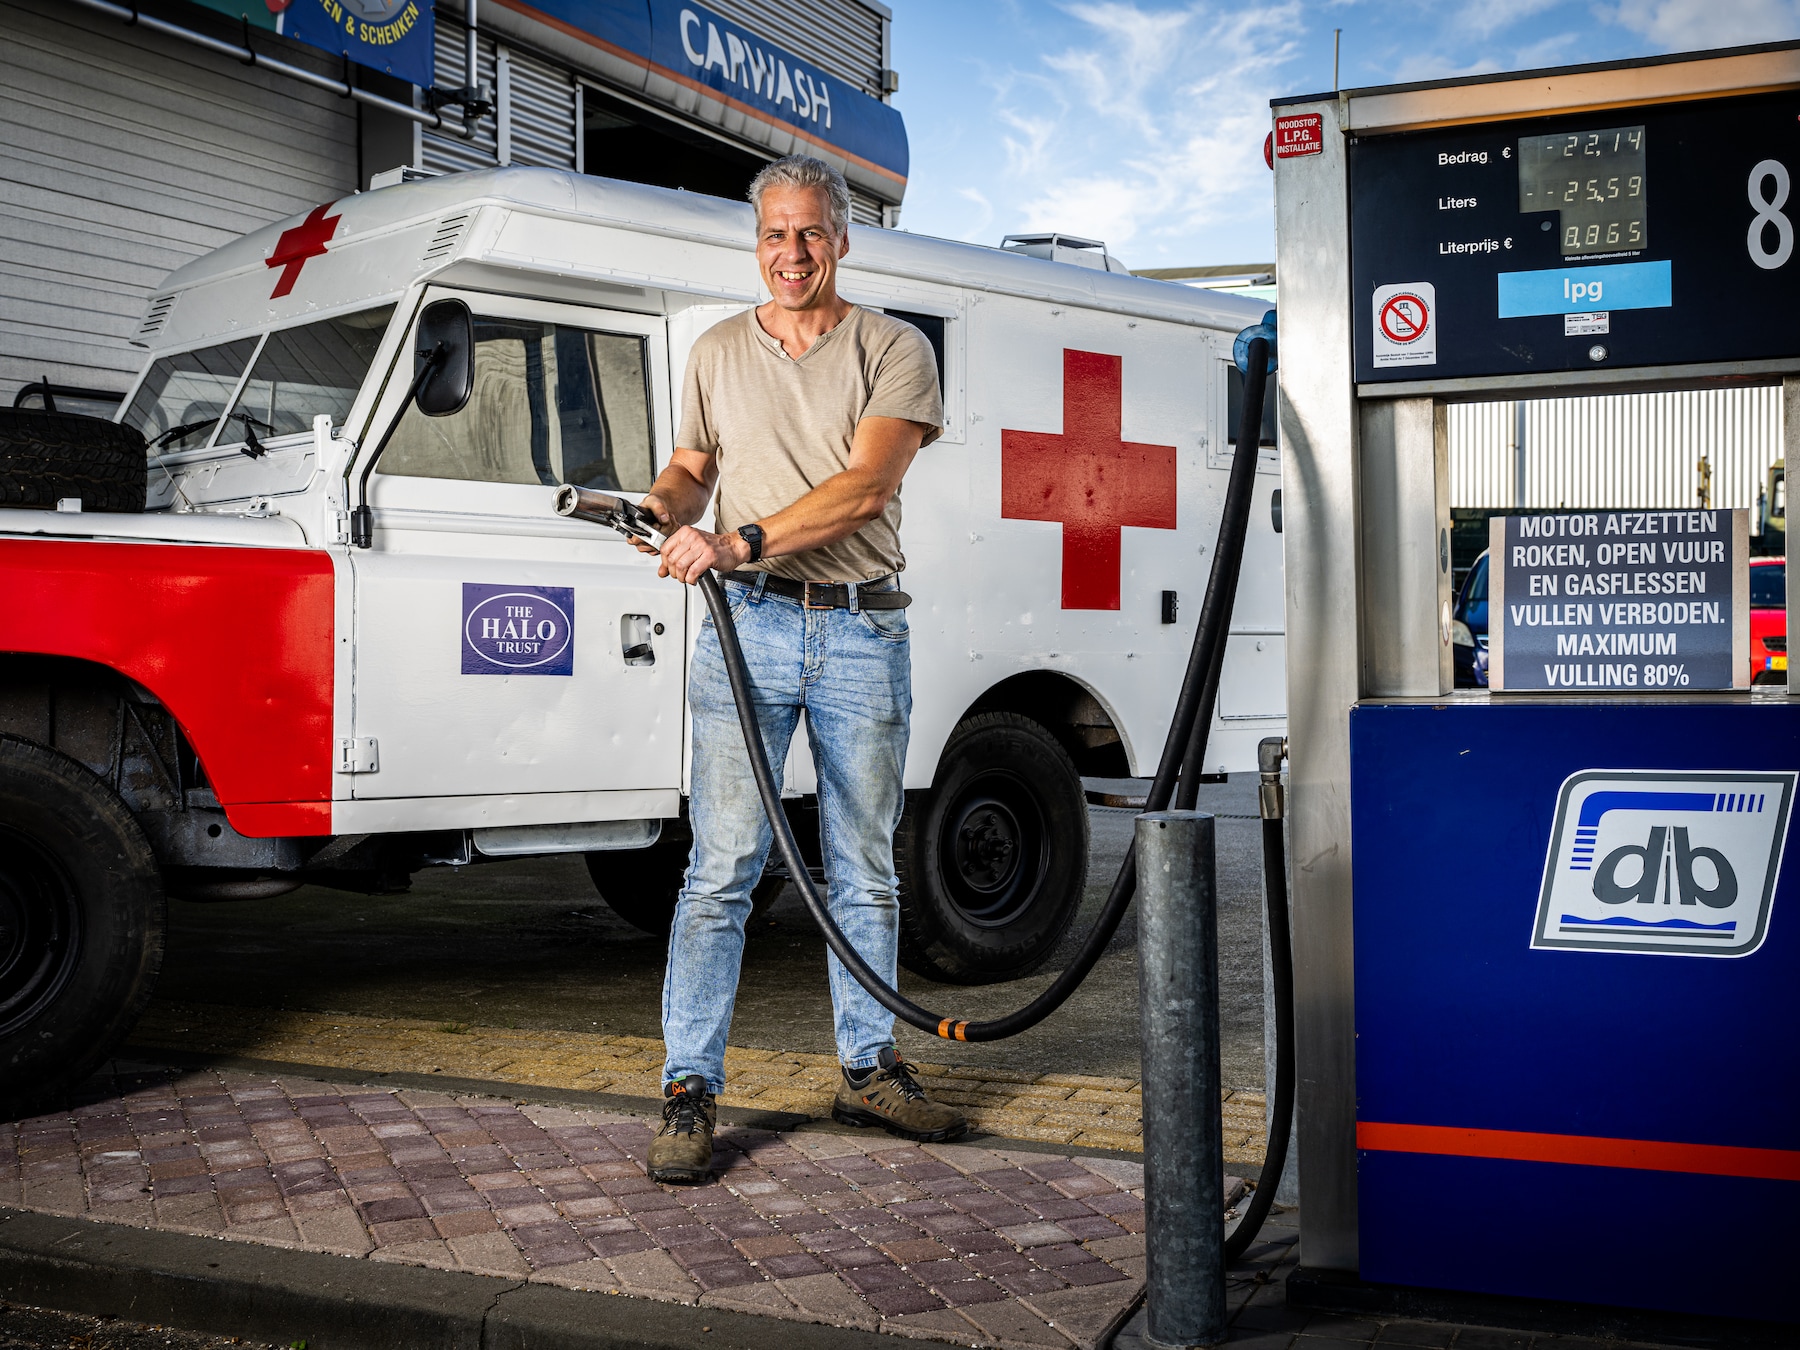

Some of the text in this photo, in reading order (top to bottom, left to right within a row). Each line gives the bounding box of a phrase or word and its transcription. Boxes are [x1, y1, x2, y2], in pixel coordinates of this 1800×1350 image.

[319, 0, 420, 45] EN & SCHENKEN
[680, 9, 831, 129] CARWASH
[1278, 118, 1318, 130] NOODSTOP
[1284, 130, 1312, 143] L.P.G.
[1277, 142, 1320, 154] INSTALLATIE
[1438, 147, 1511, 165] Bedrag €
[1439, 197, 1477, 210] Liters
[1747, 159, 1794, 270] 8
[1440, 237, 1513, 254] Literprijs €
[1564, 278, 1602, 303] lpg
[1519, 511, 1717, 537] MOTOR AFZETTEN
[1512, 541, 1725, 568] ROKEN, OPEN VUUR
[1529, 571, 1706, 596] EN GASFLESSEN
[505, 606, 533, 618] THE
[1510, 602, 1725, 626] VULLEN VERBODEN.
[481, 618, 556, 640] HALO
[496, 642, 541, 654] TRUST
[1556, 633, 1676, 656] MAXIMUM
[1544, 664, 1690, 686] VULLING 80%
